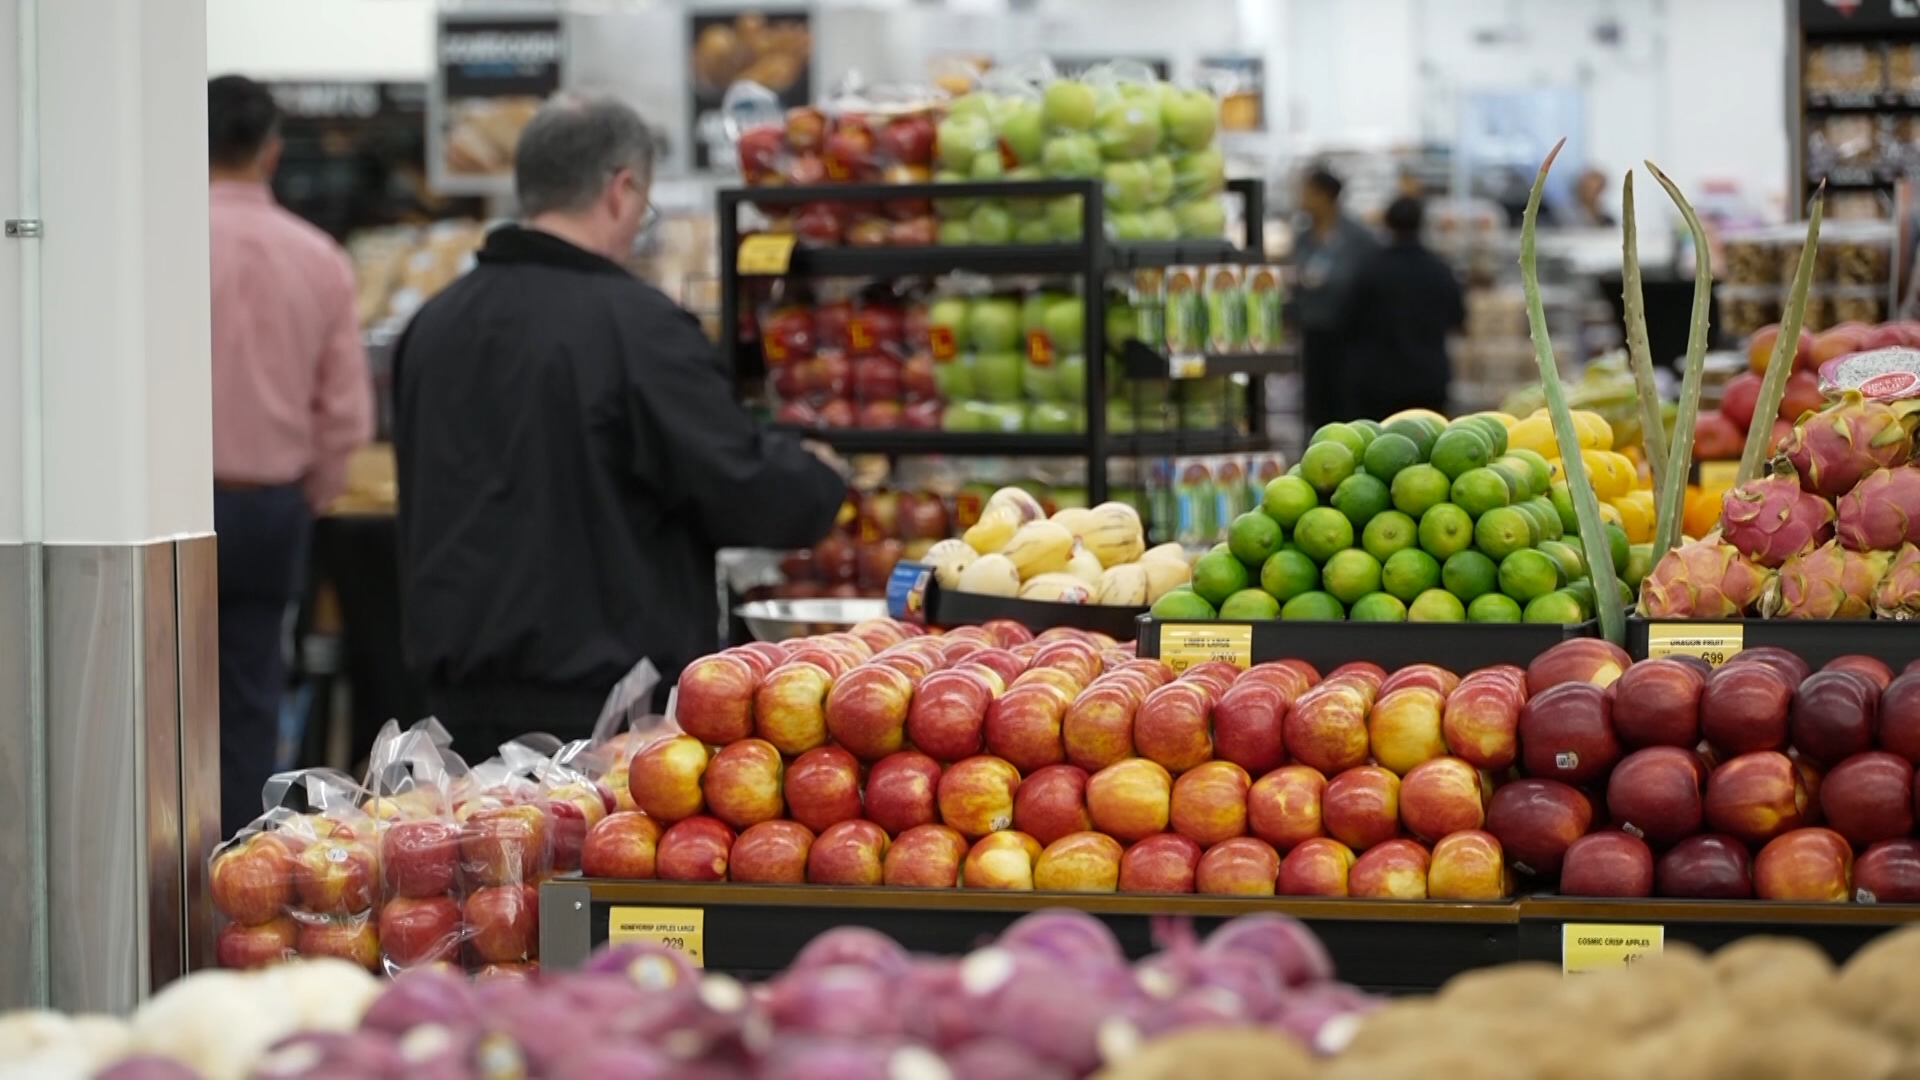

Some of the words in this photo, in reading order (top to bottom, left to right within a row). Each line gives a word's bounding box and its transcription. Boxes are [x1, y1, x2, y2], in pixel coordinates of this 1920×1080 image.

[1578, 937, 1602, 946] COSMIC
[1604, 938, 1624, 946] CRISP
[1625, 939, 1650, 948] APPLES
